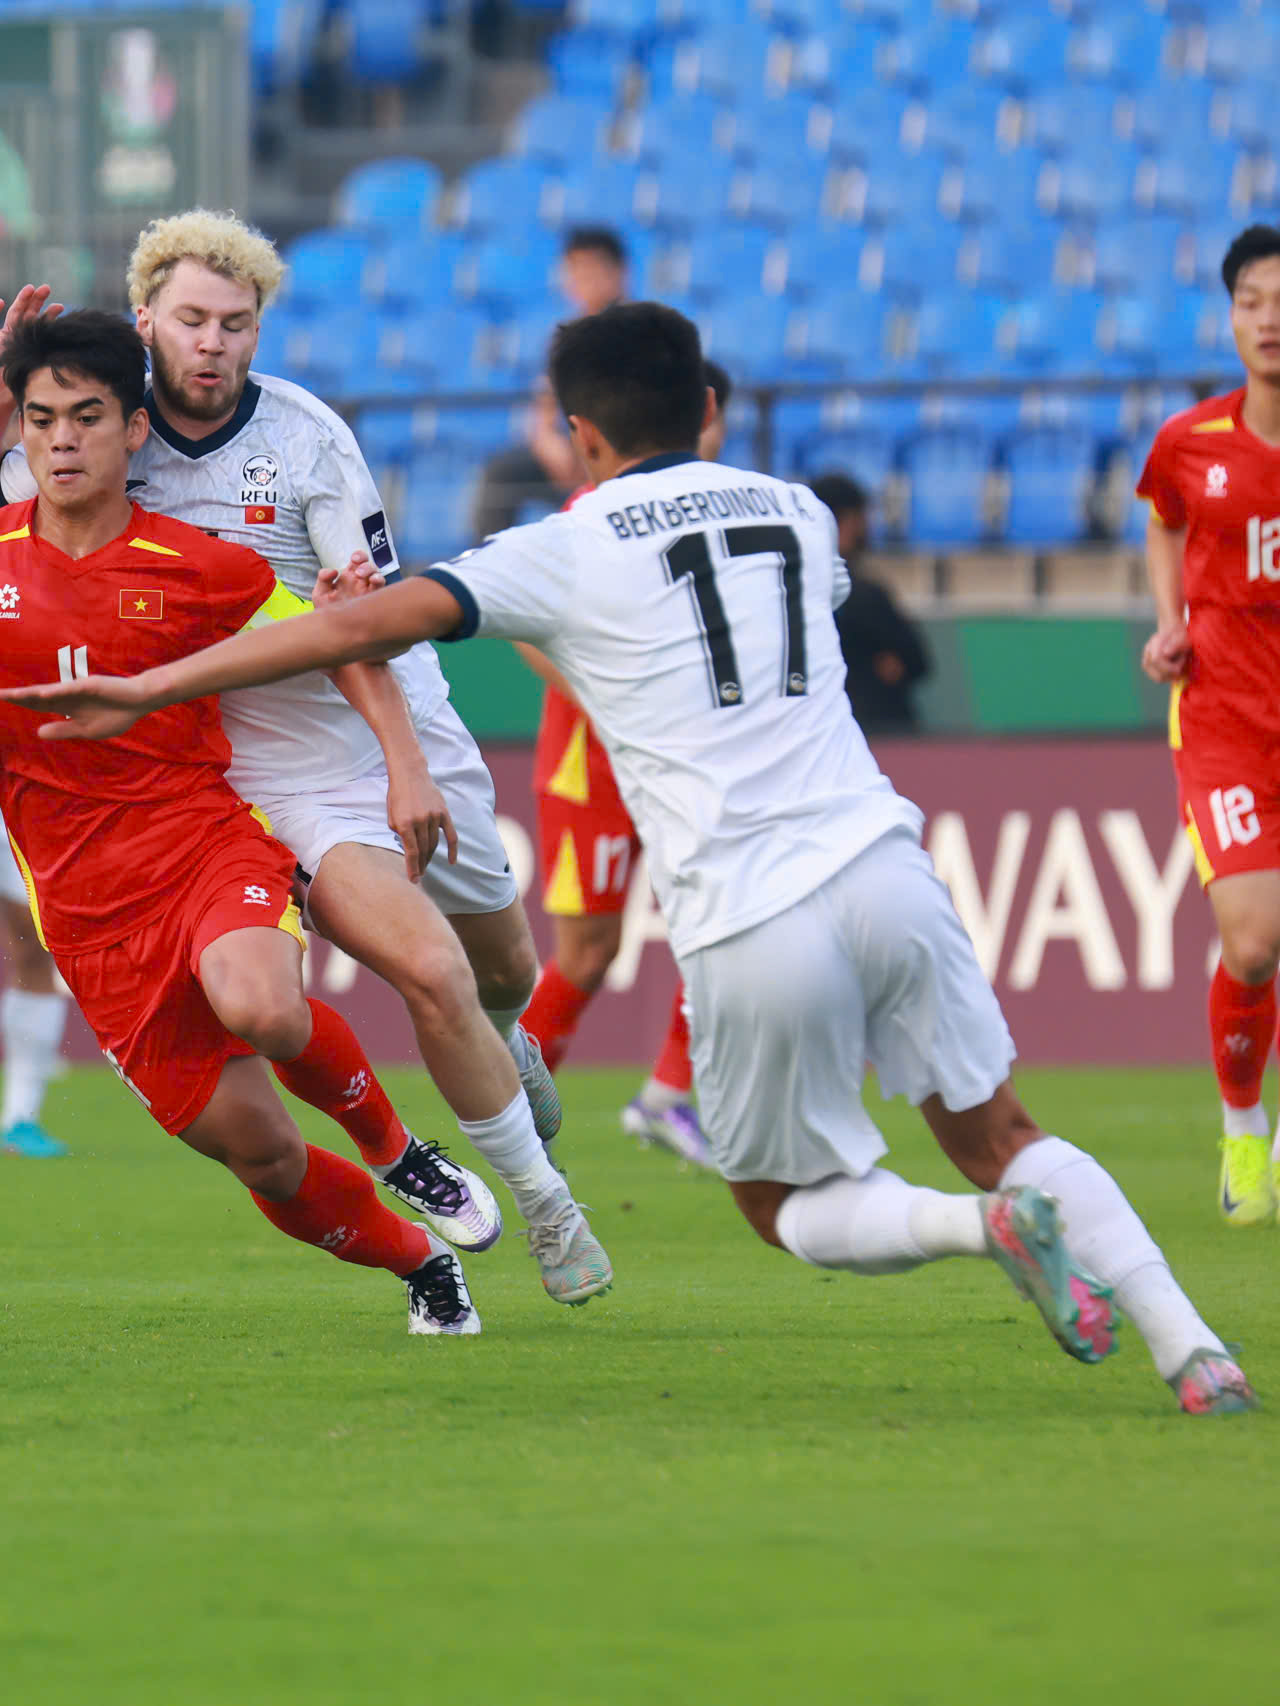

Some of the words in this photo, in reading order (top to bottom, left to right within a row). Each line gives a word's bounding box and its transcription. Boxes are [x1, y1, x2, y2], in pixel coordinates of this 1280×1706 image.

[241, 490, 277, 504] KFU
[606, 487, 784, 540] BEKBERDINOV
[371, 528, 386, 549] AFC
[660, 524, 808, 709] 17
[593, 834, 631, 895] 17
